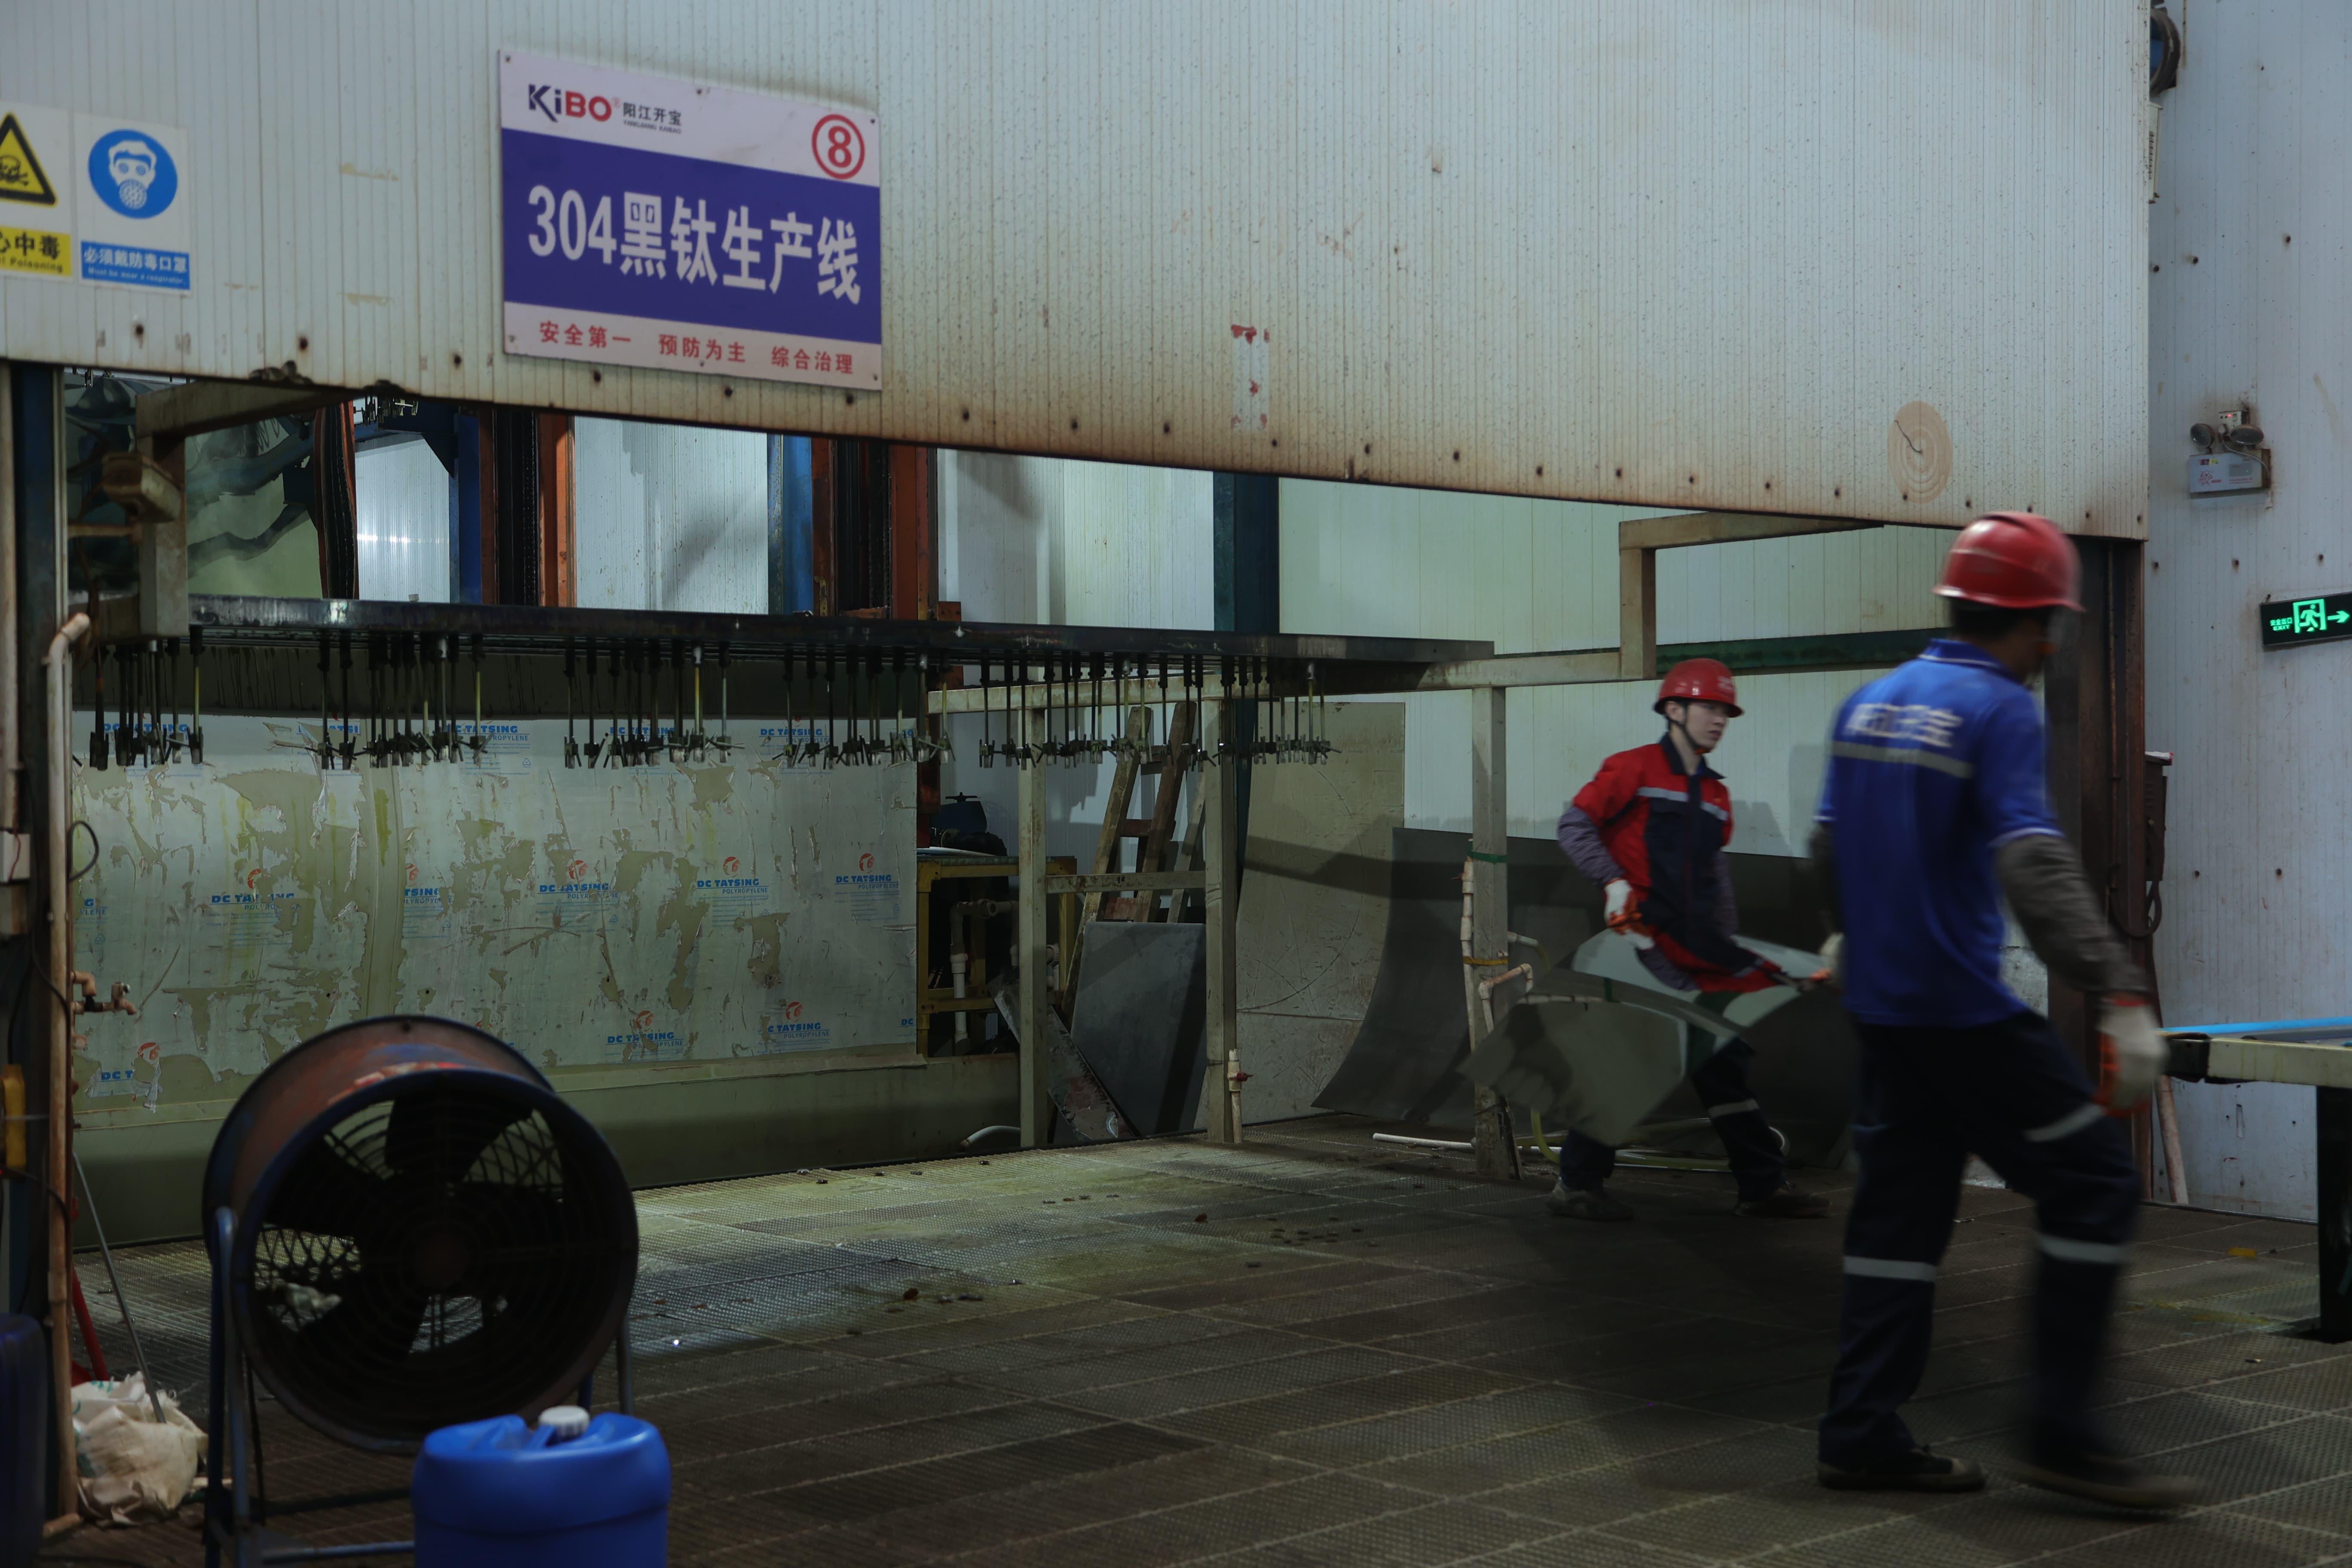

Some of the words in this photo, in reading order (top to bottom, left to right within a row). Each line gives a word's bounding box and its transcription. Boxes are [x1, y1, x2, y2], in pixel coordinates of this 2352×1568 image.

[623, 102, 681, 126] 阳江开宝
[528, 185, 860, 304] 304黑钛生产线
[539, 321, 631, 348] 安全第一
[659, 333, 745, 362] 预防为主
[771, 346, 853, 374] 综合治理
[2269, 617, 2293, 626] 安全出口
[851, 874, 891, 882] TATSING
[714, 879, 759, 887] TATSING
[777, 1023, 821, 1032] TATSING
[607, 1035, 623, 1044] DC
[101, 1071, 121, 1080] DC
